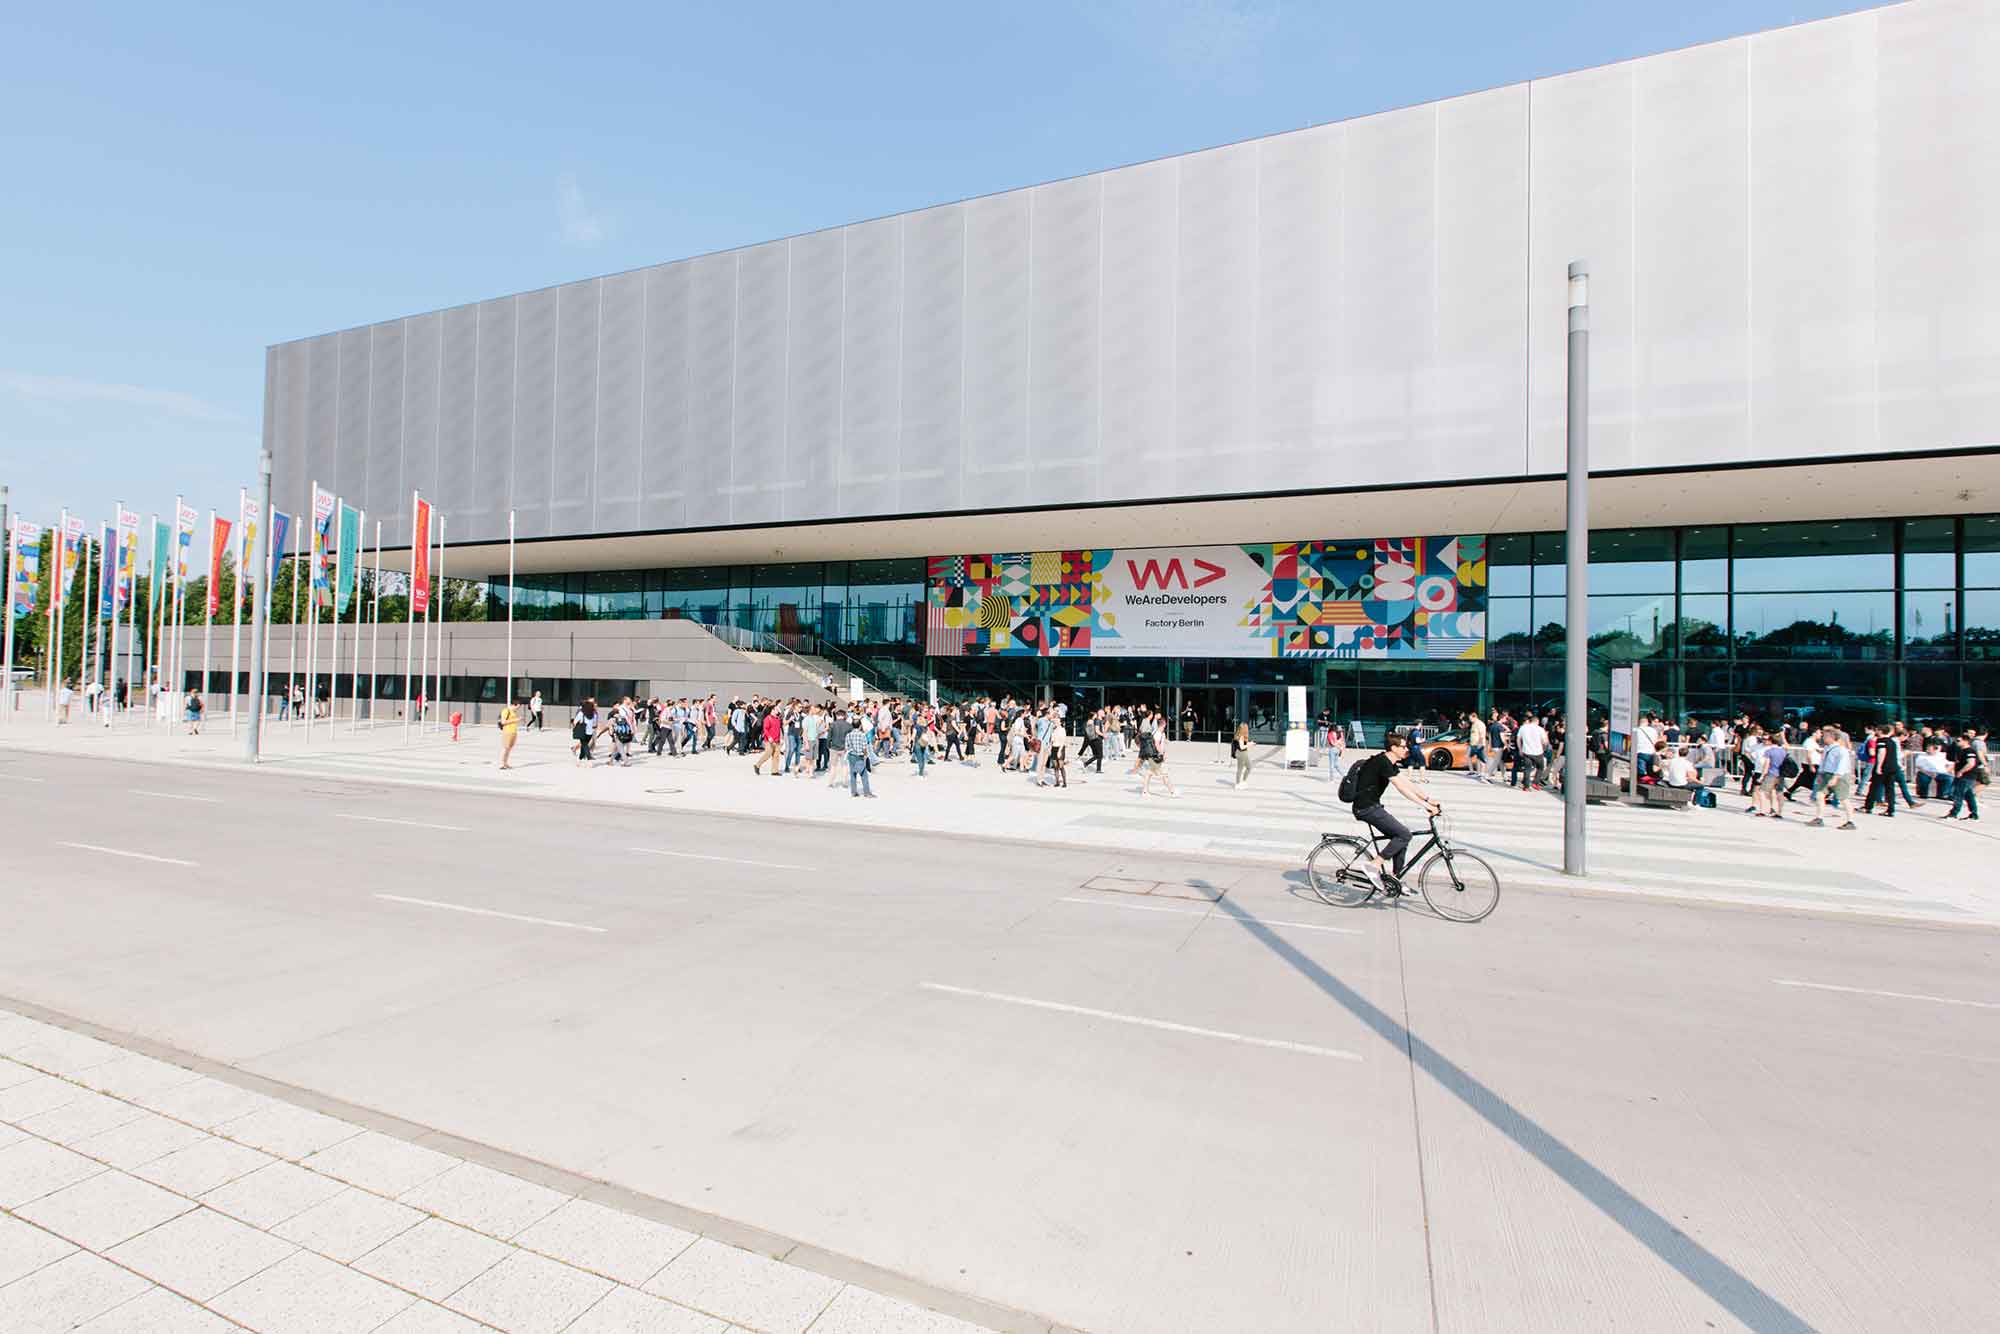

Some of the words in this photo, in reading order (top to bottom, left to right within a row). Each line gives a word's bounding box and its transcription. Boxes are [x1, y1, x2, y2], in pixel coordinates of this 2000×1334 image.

[1125, 594, 1227, 606] WeAreDevelopers
[1145, 619, 1177, 629] Factory
[1178, 618, 1205, 628] Berlin
